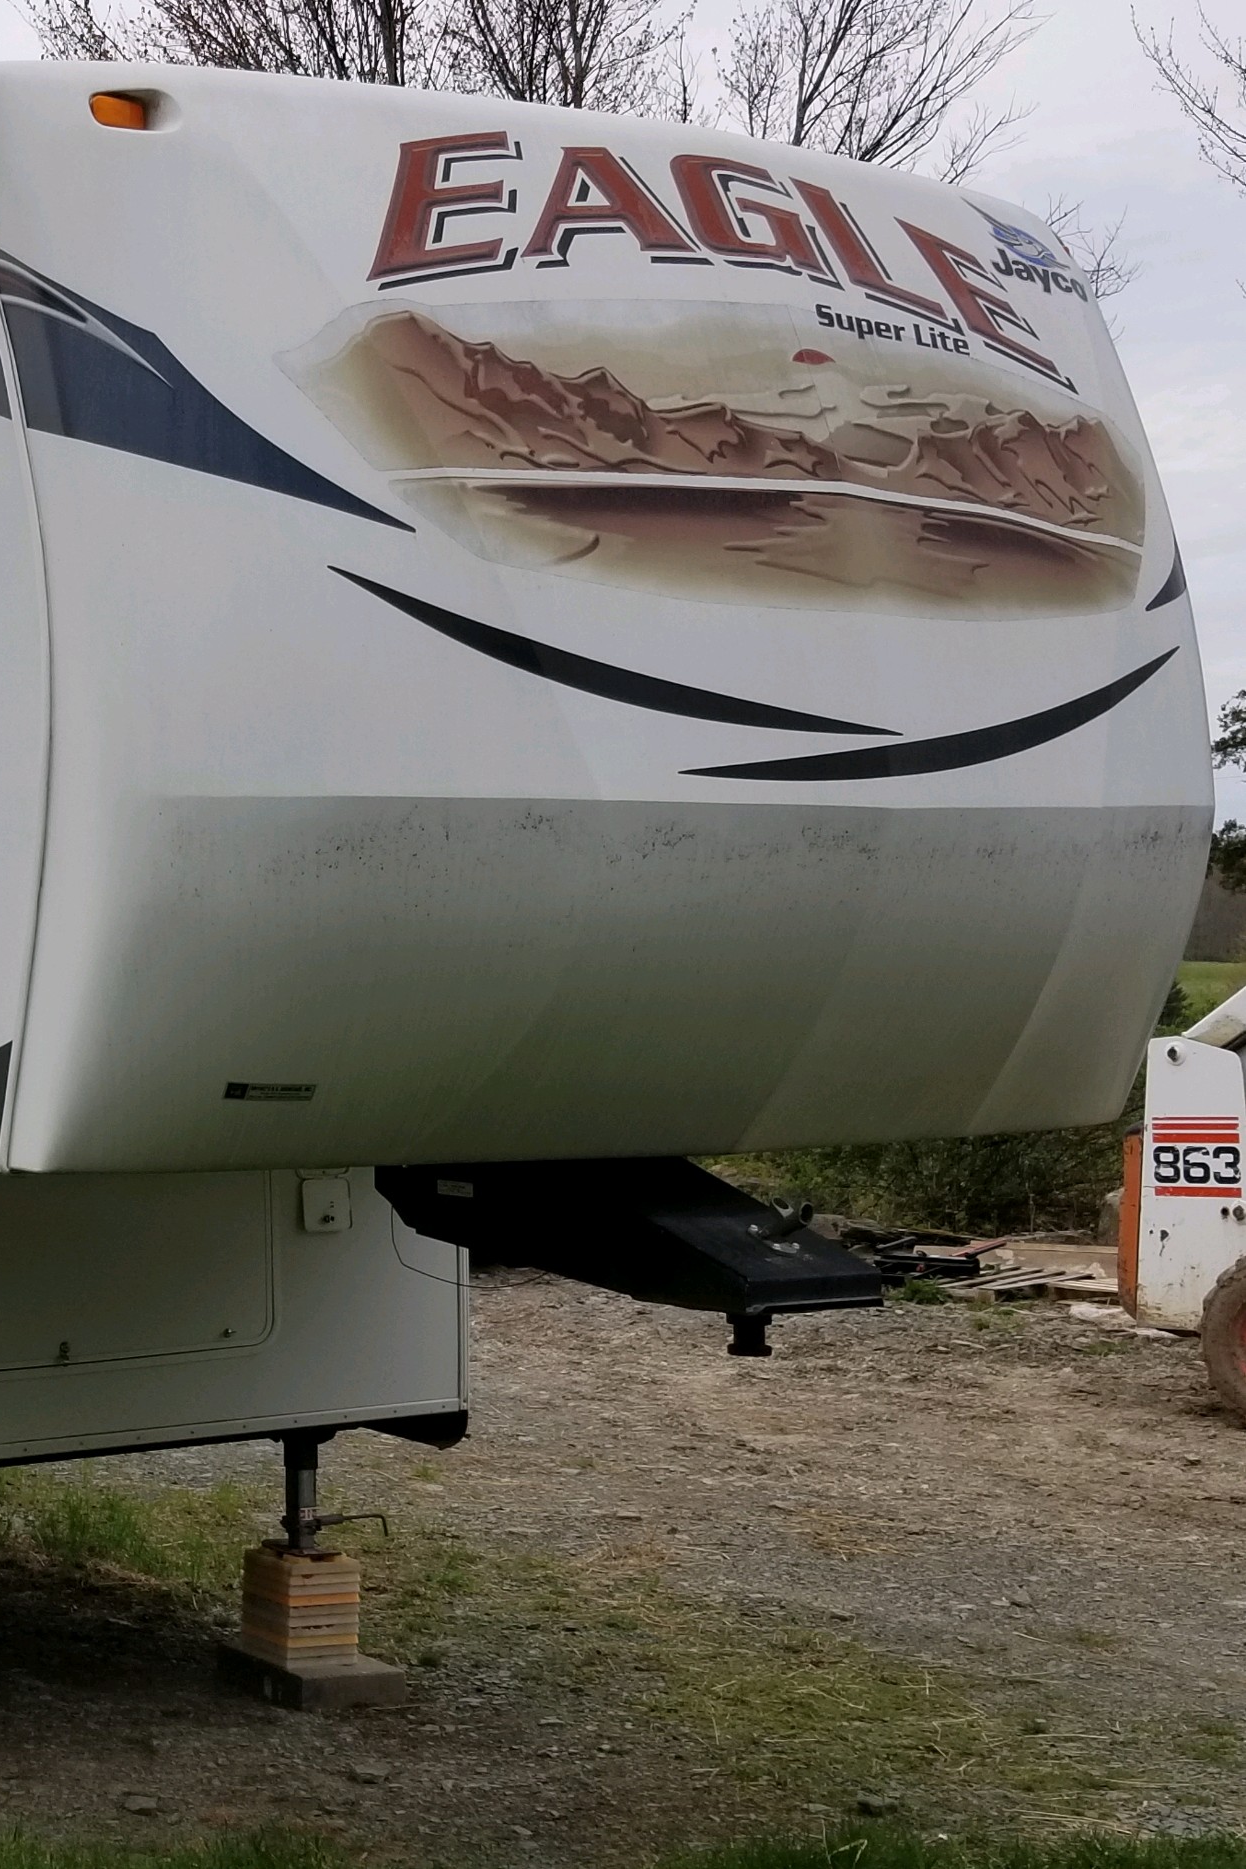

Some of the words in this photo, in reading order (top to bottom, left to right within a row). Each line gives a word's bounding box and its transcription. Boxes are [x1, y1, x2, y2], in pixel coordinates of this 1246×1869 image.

[365, 130, 1080, 396] EAGLE
[991, 247, 1089, 303] Jayco
[814, 303, 906, 341] Super
[912, 323, 972, 357] Lite
[1152, 1145, 1242, 1185] 863
